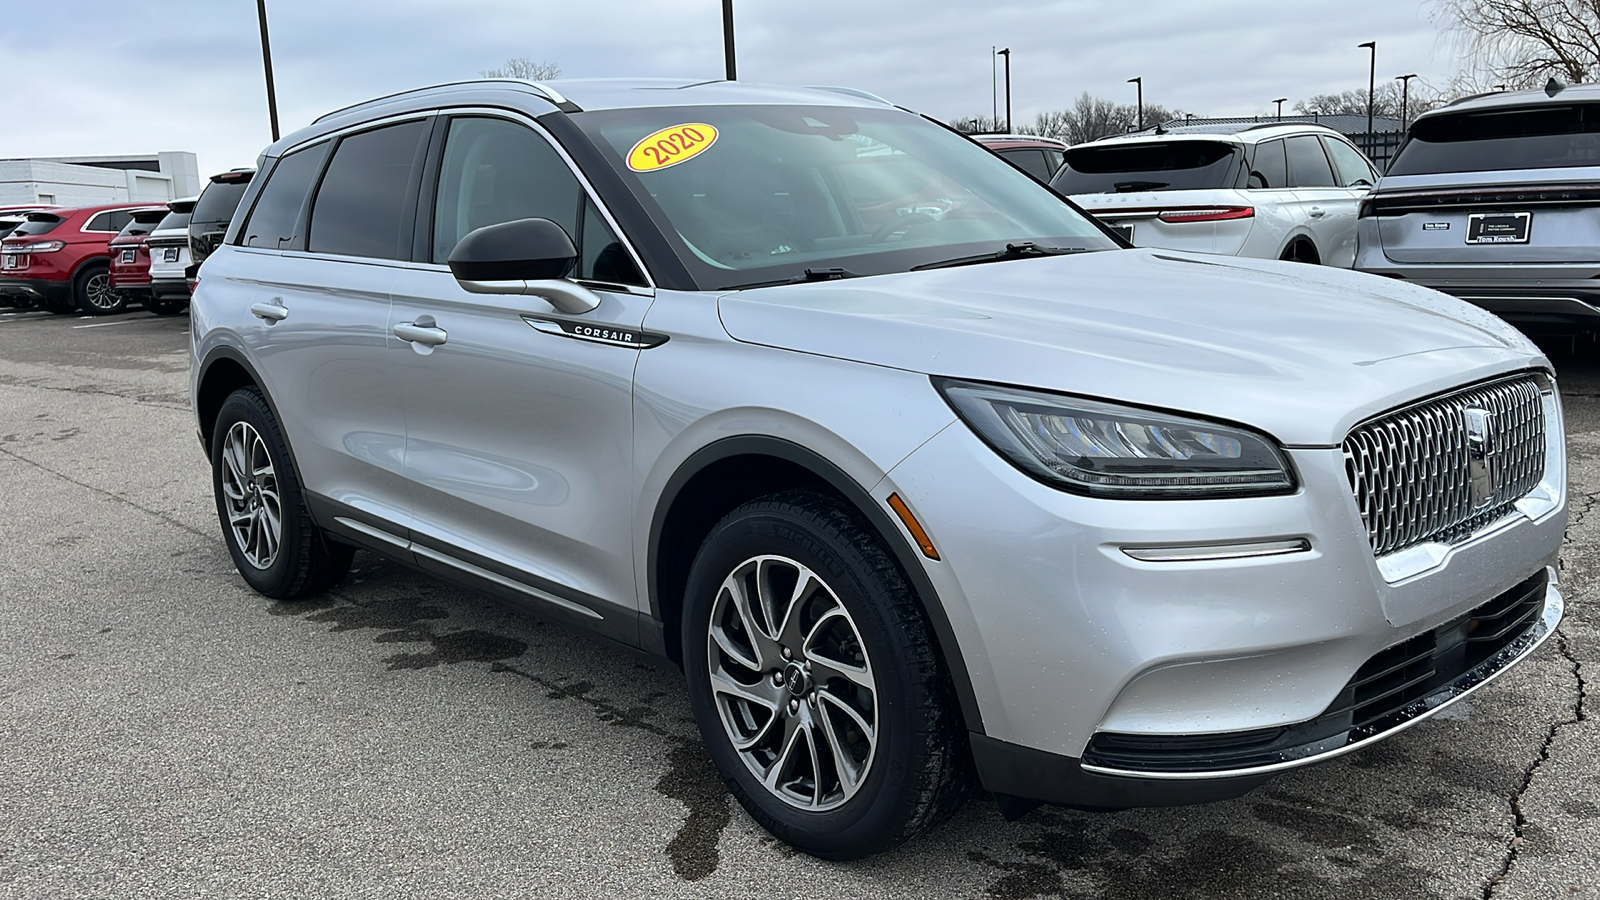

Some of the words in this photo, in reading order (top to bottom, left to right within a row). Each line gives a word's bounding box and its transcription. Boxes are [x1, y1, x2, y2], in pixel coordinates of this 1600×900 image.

[643, 127, 705, 165] 2020
[1438, 193, 1570, 203] LINCOLN
[574, 326, 633, 342] CORSAIR
[777, 526, 843, 577] MICHELIN
